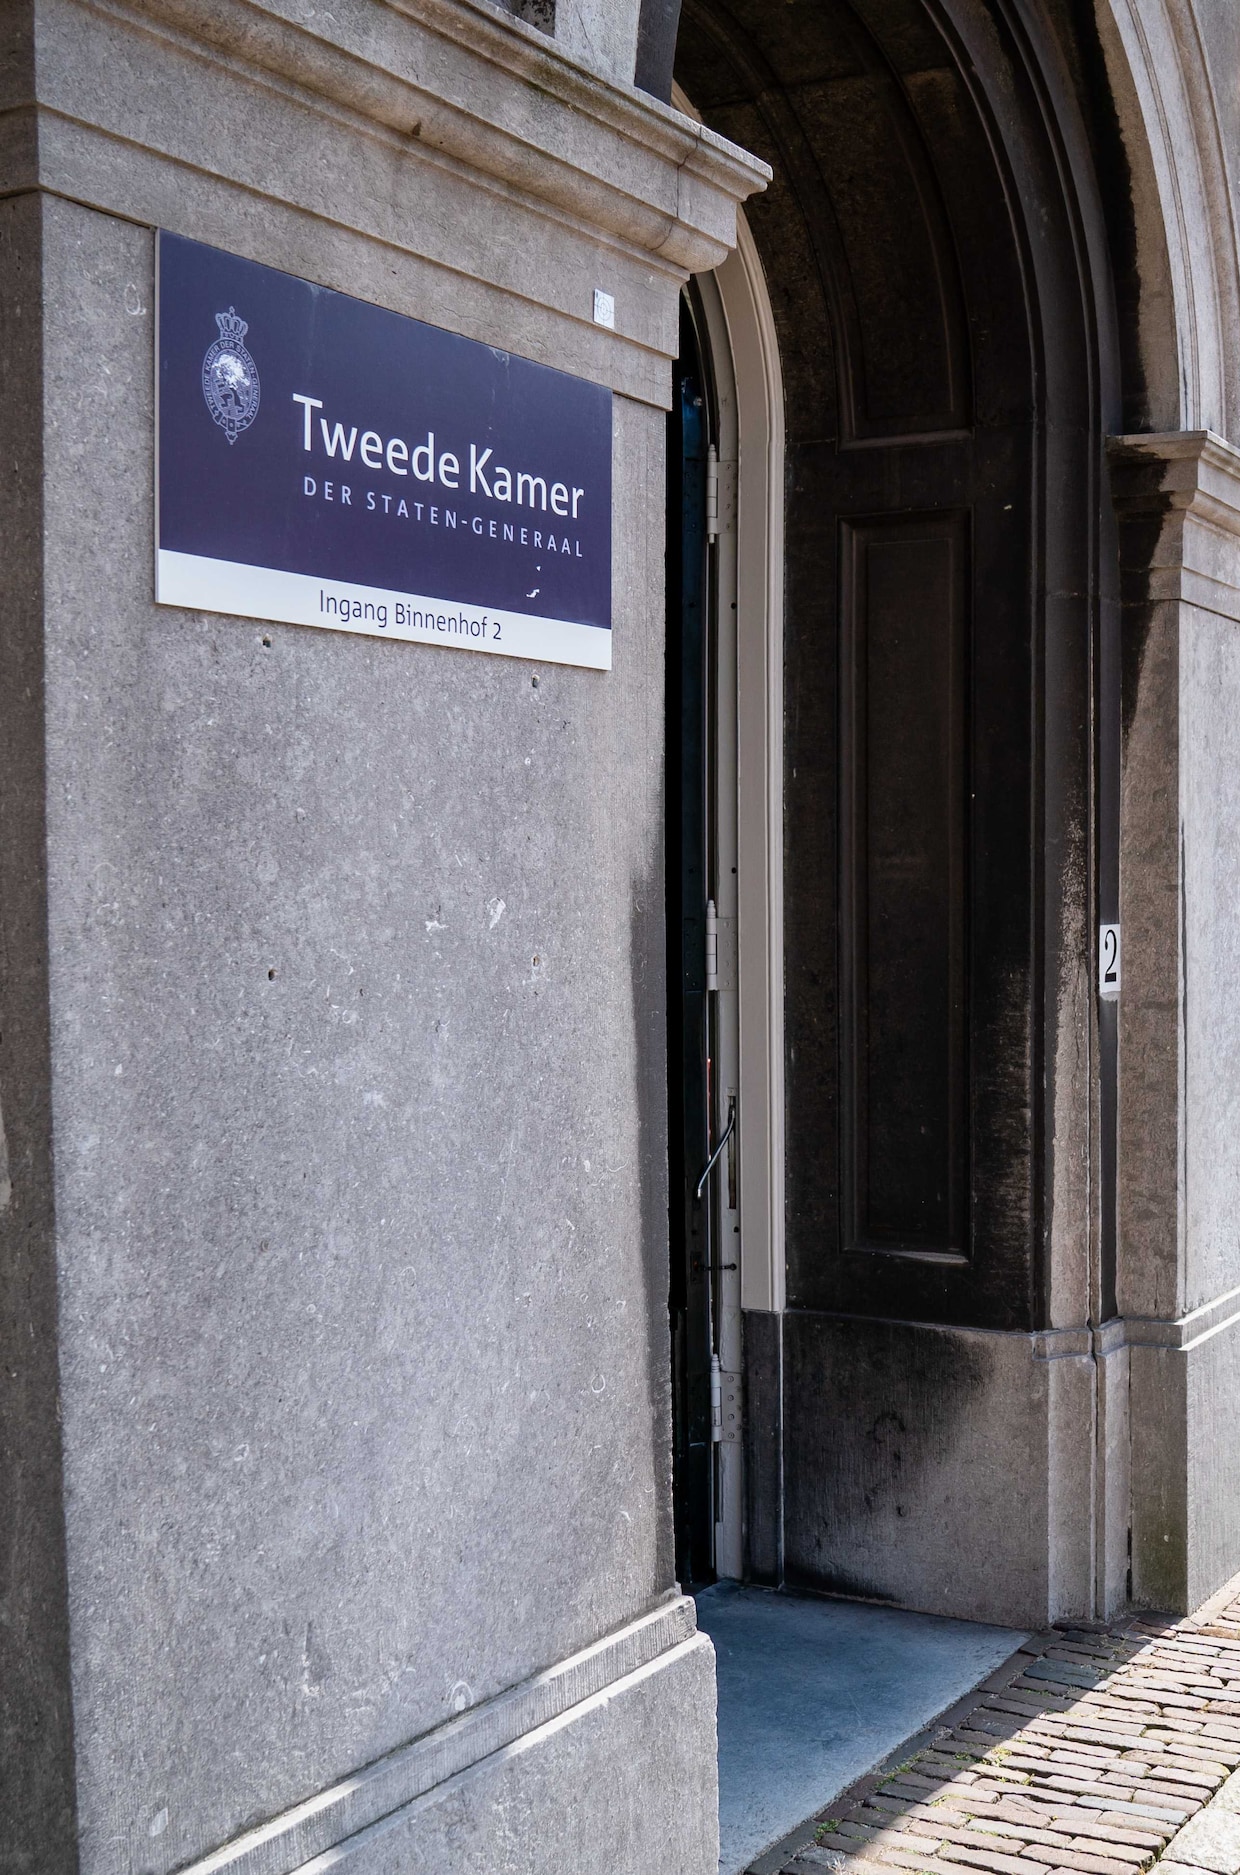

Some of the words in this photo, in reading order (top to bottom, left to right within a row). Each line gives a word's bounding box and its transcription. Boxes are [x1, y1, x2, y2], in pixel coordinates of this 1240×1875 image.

[204, 344, 221, 372] KAMER
[219, 340, 235, 349] DER
[292, 393, 460, 489] Tweede
[469, 443, 585, 519] Kamer
[303, 476, 352, 505] DER
[367, 491, 584, 558] STATEN-GENERAAL
[319, 590, 388, 627] Ingang
[395, 602, 488, 639] Binnenhof
[492, 622, 502, 641] 2
[1104, 929, 1117, 983] 2
